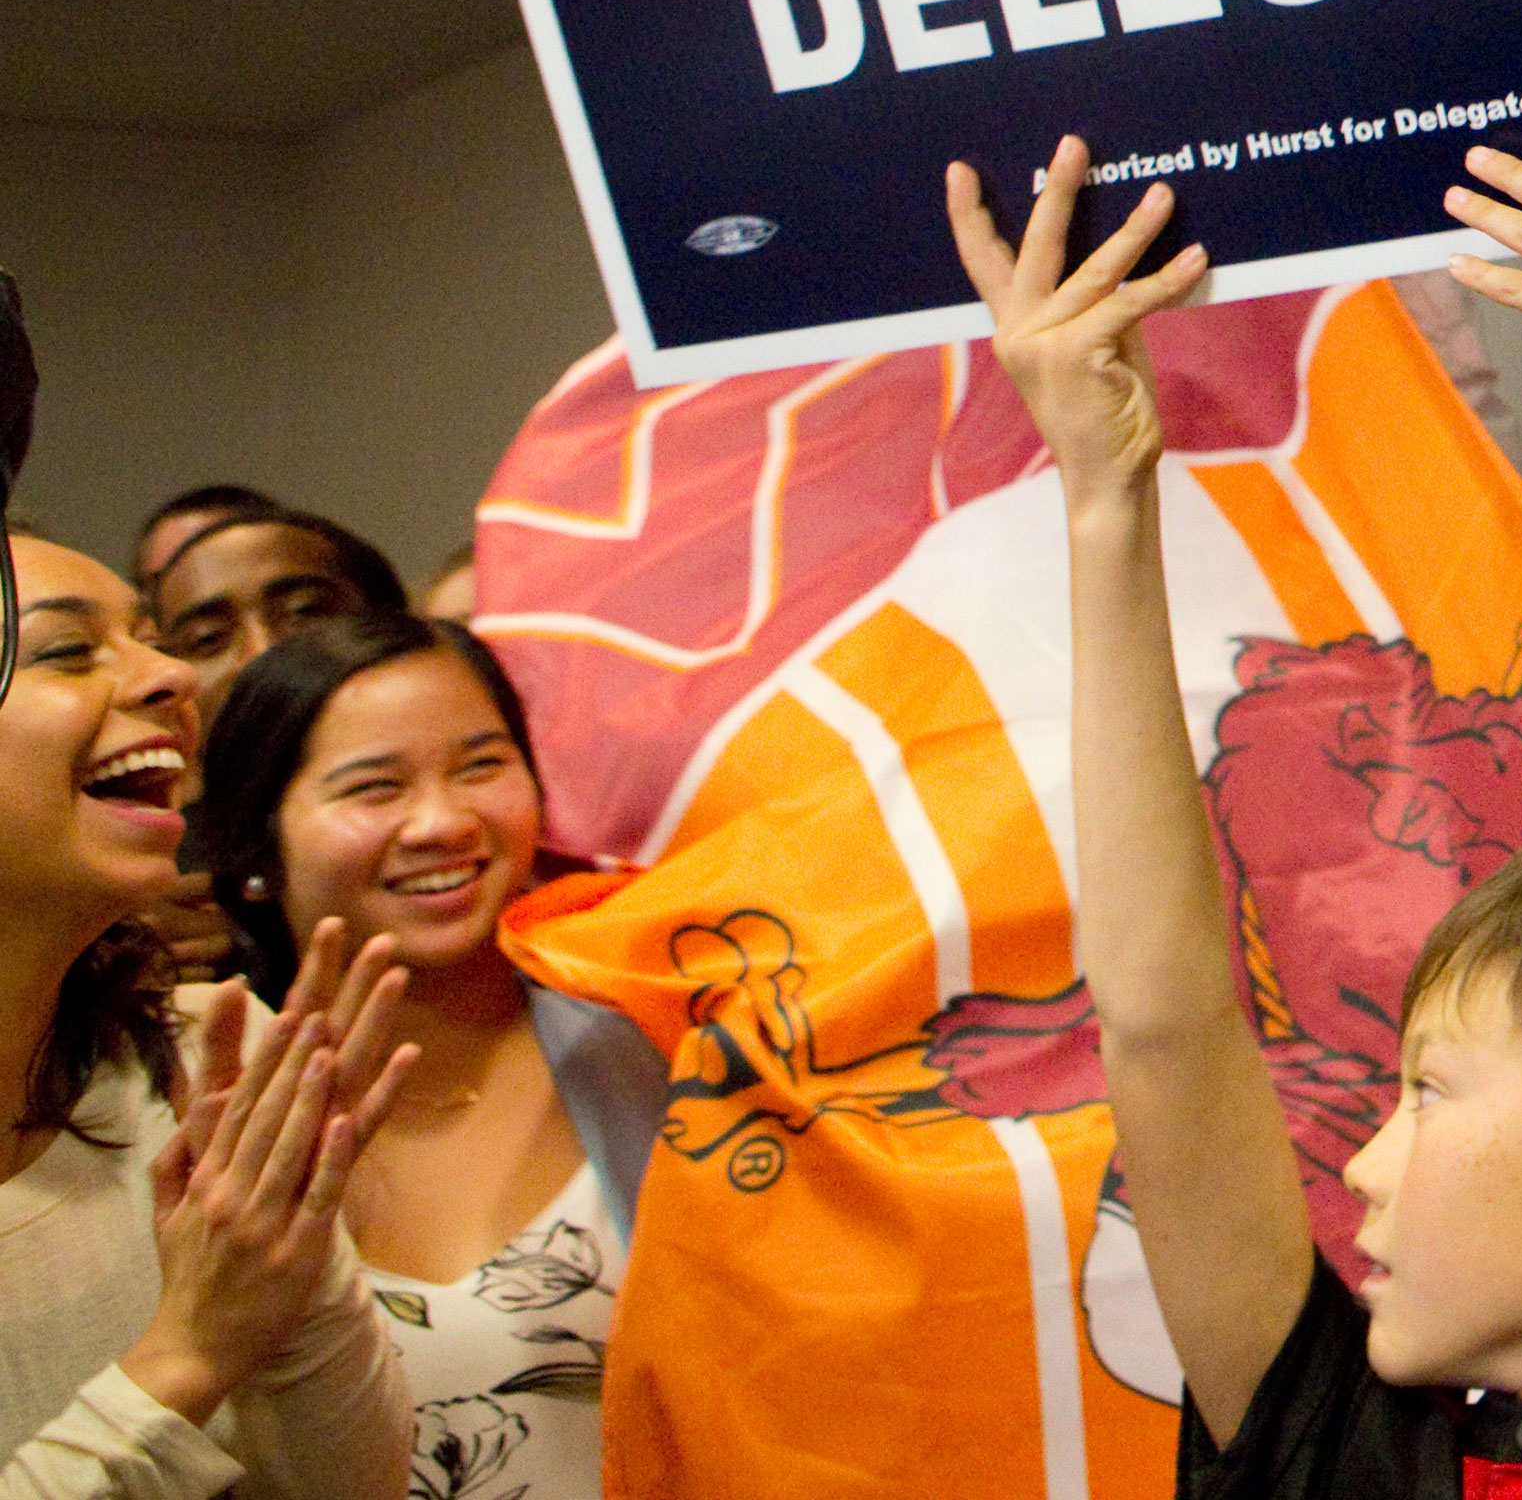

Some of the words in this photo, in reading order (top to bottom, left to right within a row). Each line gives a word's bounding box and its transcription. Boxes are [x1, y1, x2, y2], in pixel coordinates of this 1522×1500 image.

[1201, 139, 1238, 170] by
[1246, 121, 1335, 160] Hurst
[1340, 115, 1386, 145] for
